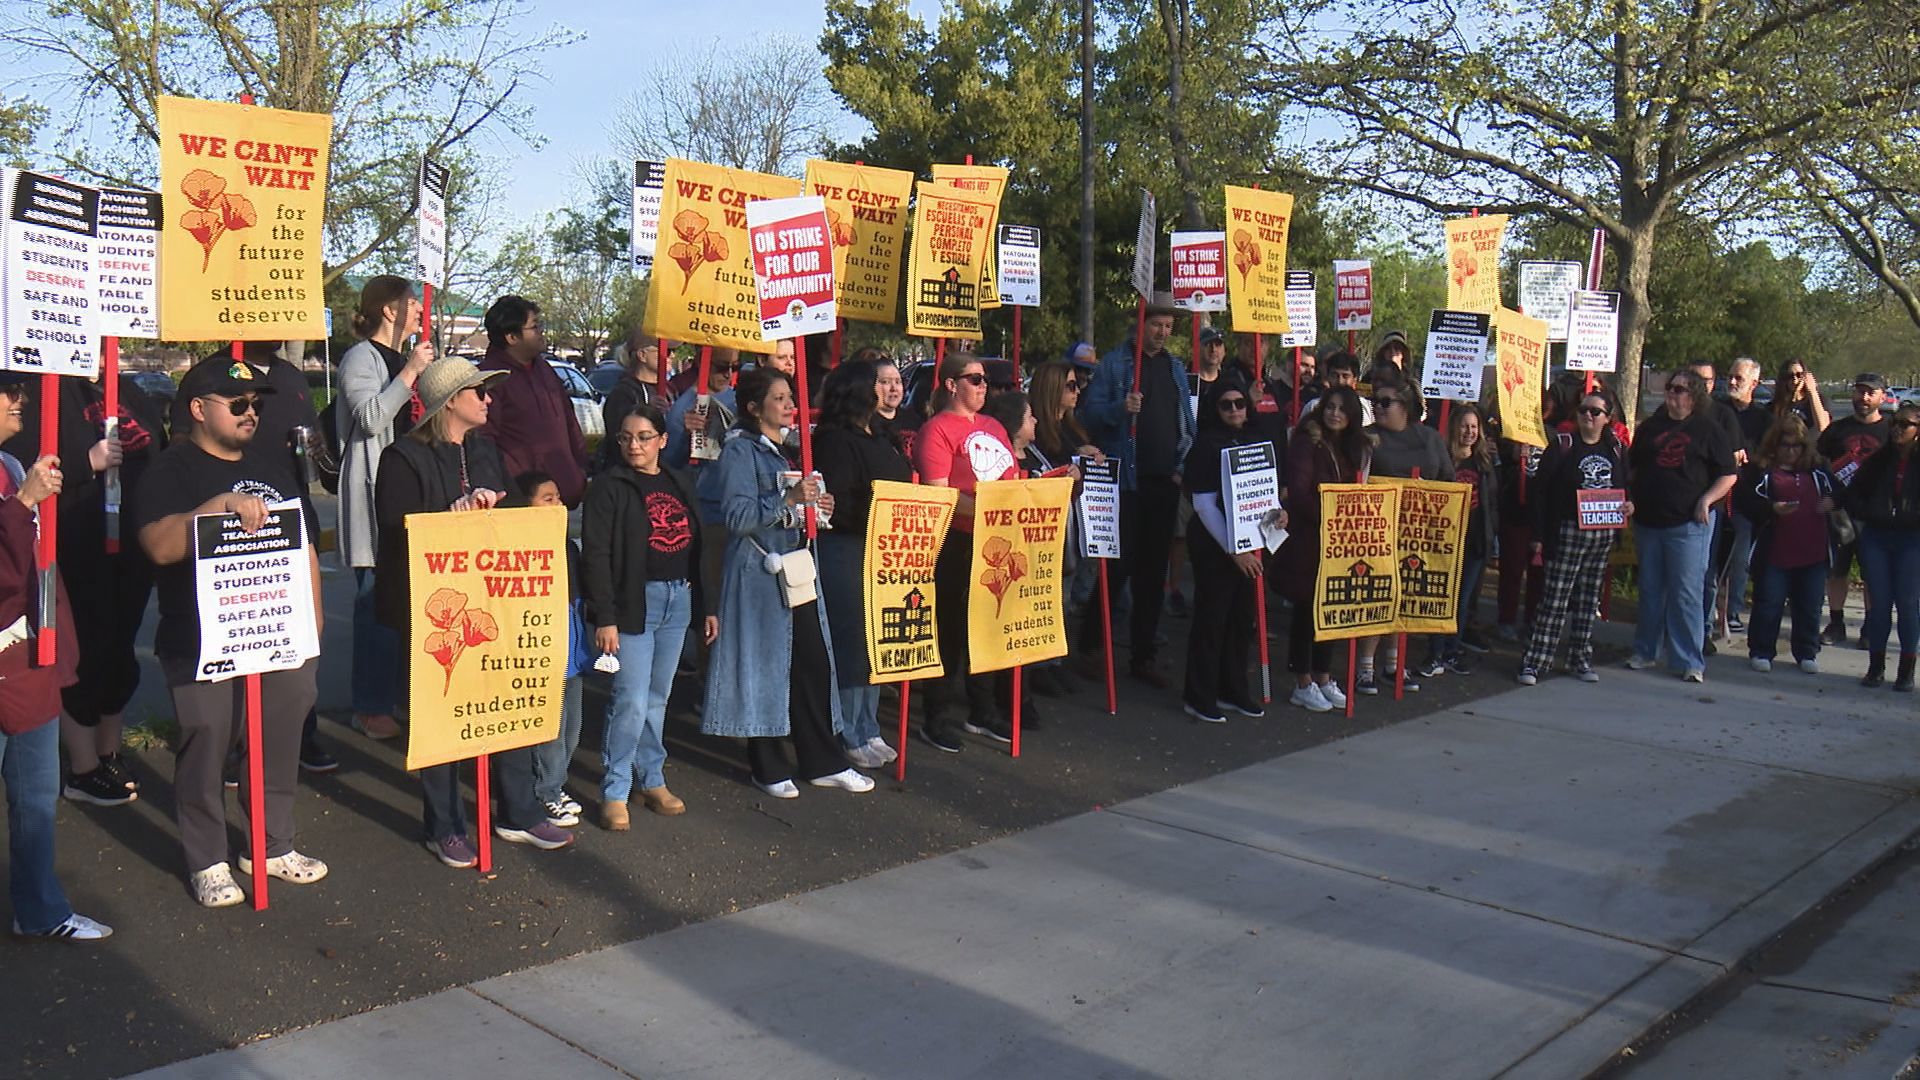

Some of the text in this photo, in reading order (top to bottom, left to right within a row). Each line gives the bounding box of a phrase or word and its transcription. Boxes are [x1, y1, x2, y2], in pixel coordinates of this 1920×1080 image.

[179, 134, 318, 166] WE CAN'T
[244, 166, 315, 190] WAIT
[34, 181, 82, 201] NATOMAS
[676, 179, 712, 202] WE
[814, 184, 900, 209] WE CAN'T
[32, 196, 83, 216] TEACHERS
[99, 193, 148, 205] ATOMAS
[24, 208, 89, 230] ASSOCIATION
[276, 204, 306, 220] for
[852, 204, 897, 226] WAIT
[1232, 208, 1285, 229] WE CAN'T
[968, 215, 984, 230] CON
[272, 226, 304, 240] the
[754, 226, 824, 254] ON STRIKE
[874, 232, 894, 244] for
[1258, 226, 1284, 242] WAIT
[1452, 231, 1468, 244] WE
[23, 231, 88, 252] NATOMAS
[98, 246, 154, 258] UDENTS
[239, 244, 304, 260] future
[870, 245, 892, 258] the
[931, 252, 937, 262] Y
[1174, 250, 1220, 262] ON STRIKE
[1268, 250, 1280, 261] for
[22, 250, 88, 272] STUDENTS
[764, 255, 790, 277] FOR
[792, 251, 820, 272] OUR
[845, 254, 890, 271] future
[1266, 262, 1279, 272] the
[269, 268, 304, 280] our
[715, 268, 756, 287] futur
[1178, 264, 1216, 276] FOR OUR
[26, 270, 86, 290] DESERVE
[120, 276, 152, 286] AND
[864, 272, 888, 284] our
[1004, 276, 1016, 284] THE
[1174, 277, 1224, 288] COMMUNITY
[99, 289, 143, 300] TABLE
[211, 286, 306, 300] students
[760, 274, 832, 300] COMMUNITY
[834, 280, 886, 297] udents
[1266, 288, 1279, 298] our
[23, 289, 88, 309] SAFE AND
[735, 292, 757, 305] ou
[836, 296, 885, 312] eserve
[100, 304, 149, 314] HOOLS
[218, 308, 308, 324] deserve
[32, 310, 82, 326] STABLE
[762, 320, 782, 330] CTA
[26, 328, 87, 345] SCHOOLS
[688, 320, 761, 340] deserve
[1436, 335, 1480, 344] NATOMAS
[1500, 331, 1516, 345] WE
[12, 346, 42, 366] CTA
[1434, 344, 1479, 354] STUDENTS
[1436, 352, 1475, 362] DESERVE
[1441, 362, 1466, 370] FULLY
[1434, 370, 1472, 379] STAFFED
[1432, 378, 1472, 387] SCHOOLS
[1236, 476, 1274, 489] NATOMAS
[1236, 488, 1274, 501] STUDENTS
[1336, 493, 1384, 504] STUDENTS NEED
[1429, 493, 1449, 505] NEED
[892, 504, 926, 518] STUDENTS
[1238, 500, 1272, 512] DESERVE
[1336, 503, 1382, 517] FULLY
[1400, 500, 1446, 516] ULLY
[222, 515, 280, 530] NAAS
[984, 507, 1061, 526] WE CAN'T
[1238, 514, 1252, 524] THE
[1327, 516, 1390, 531] STAFFED,
[1400, 513, 1456, 530] AFFED,
[1582, 512, 1624, 524] TEACHERS
[1022, 526, 1058, 543] WAIT
[1329, 531, 1386, 545] STABLE
[1400, 526, 1446, 542] ABLE
[214, 539, 290, 554] ASSOCIATION
[1326, 544, 1392, 559] SCHOOLS
[1398, 540, 1454, 555] HOOLS
[424, 550, 554, 574] WE CAN'T
[1038, 551, 1054, 564] for
[214, 557, 290, 574] NATOMAS
[1035, 567, 1052, 580] the
[213, 573, 292, 590] STUDENTS
[484, 576, 554, 598] WAIT
[219, 588, 288, 606] DESERVE
[1019, 584, 1052, 598] future
[1033, 600, 1052, 612] our
[1418, 601, 1447, 616] WAIT!
[218, 605, 292, 624] SAFE AND
[522, 610, 552, 628] for
[1324, 605, 1390, 626] WE CAN'T WAIT!
[228, 622, 286, 638] STABLE
[1003, 615, 1054, 634] students
[221, 638, 290, 655] SCHOOLS
[518, 632, 552, 648] the
[1006, 633, 1056, 651] deserve
[480, 654, 551, 672] future
[880, 650, 892, 668] WE
[893, 648, 916, 666] CAN'T
[202, 660, 236, 675] CTA
[512, 676, 550, 690] our
[454, 695, 548, 718] students
[460, 716, 544, 740] deserve
